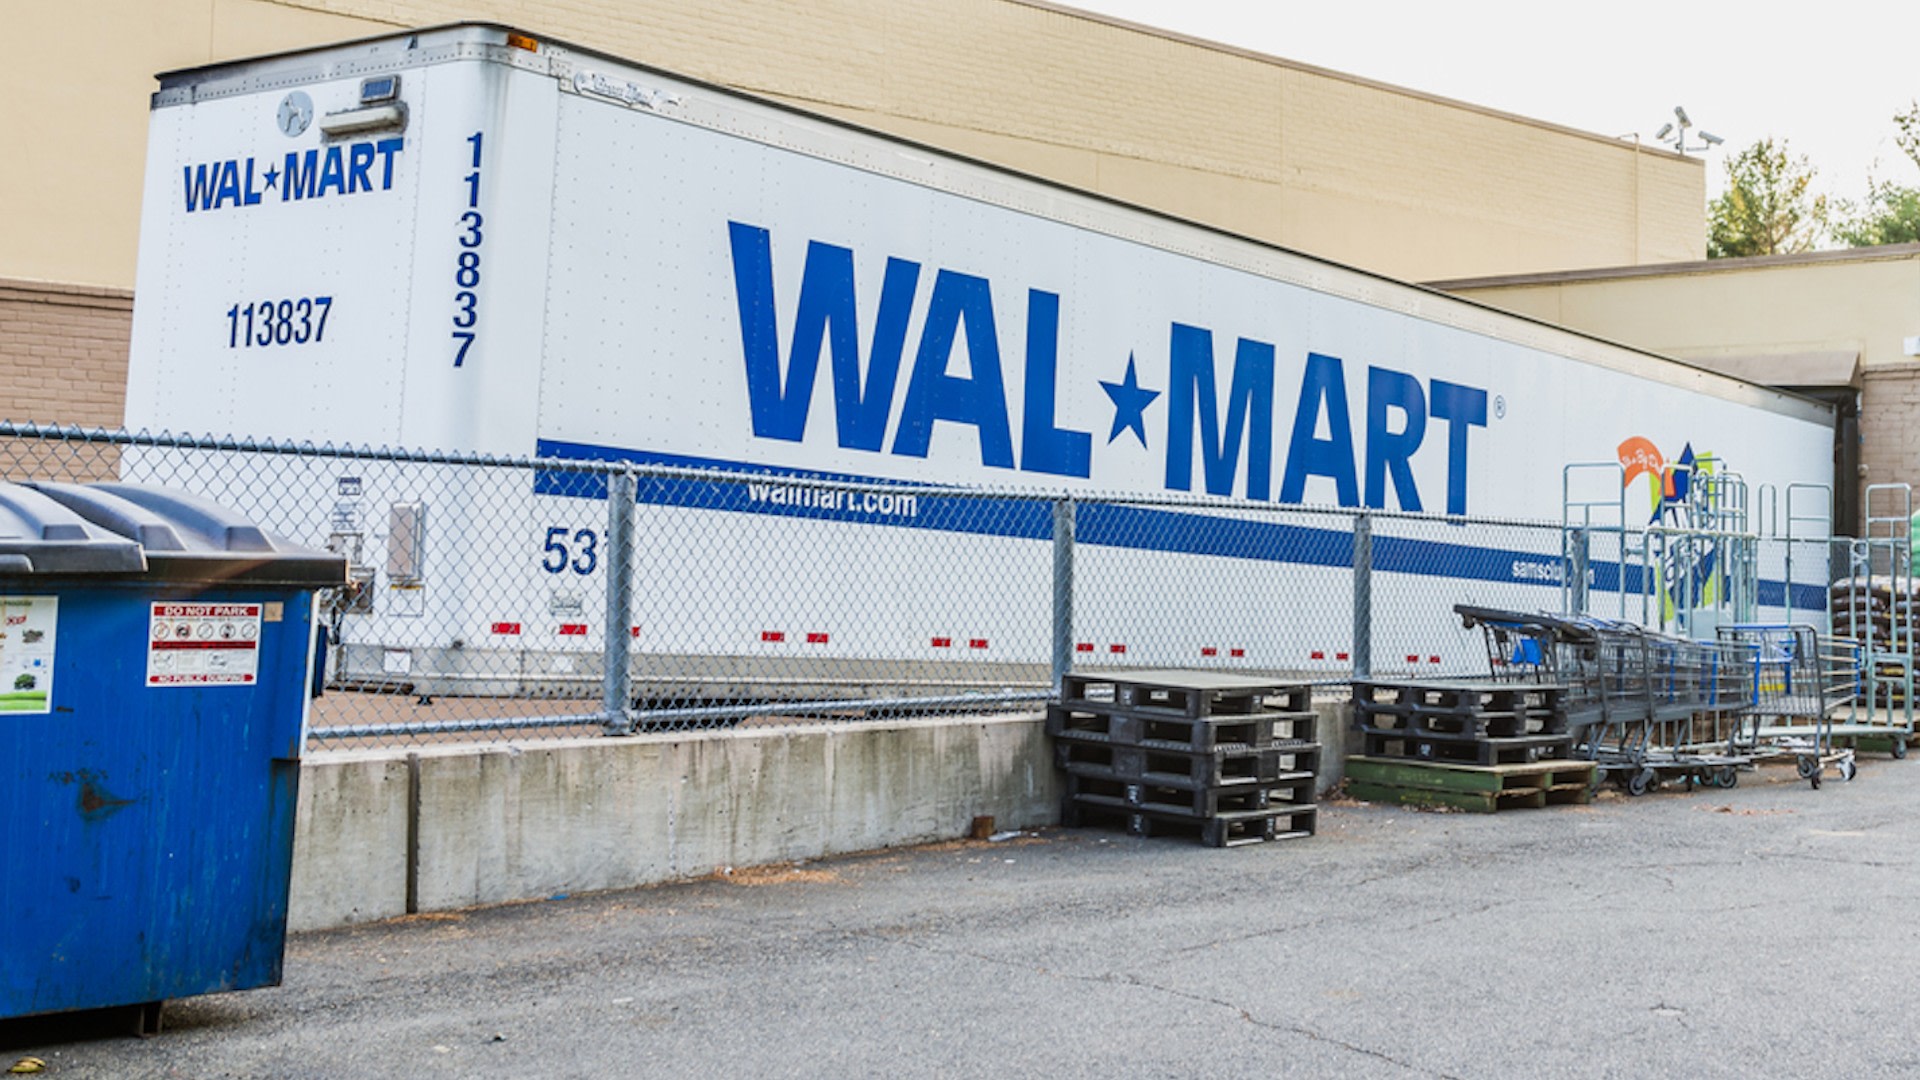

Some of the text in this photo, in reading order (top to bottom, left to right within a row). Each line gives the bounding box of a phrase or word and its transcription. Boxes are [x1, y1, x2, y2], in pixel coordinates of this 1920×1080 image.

[227, 296, 333, 348] 113837
[164, 606, 248, 616] DO NOT PARK
[173, 674, 207, 682] PUBLIC
